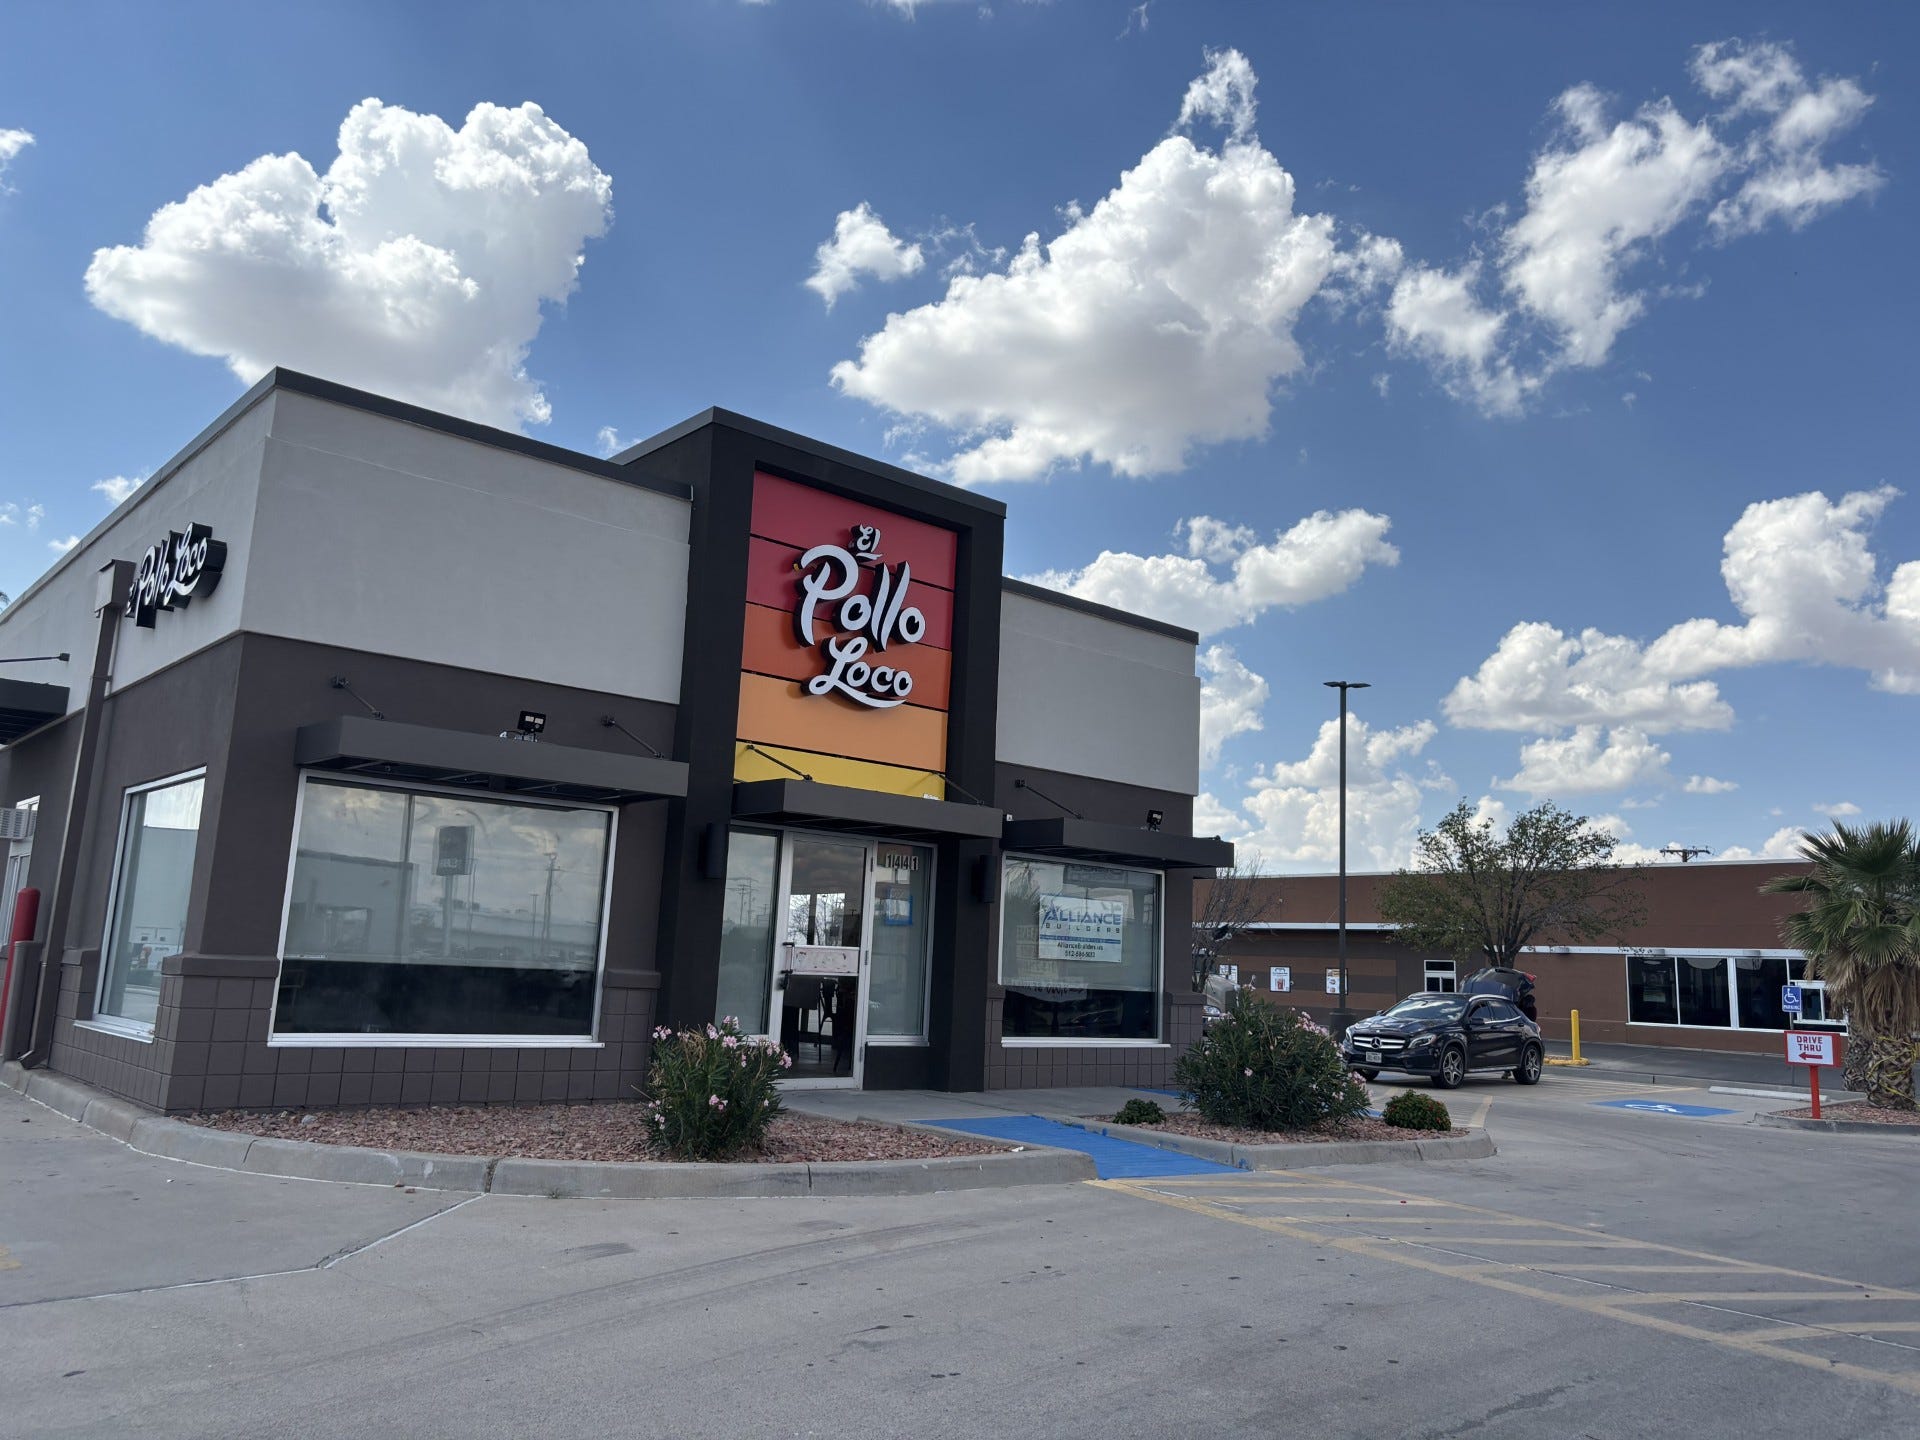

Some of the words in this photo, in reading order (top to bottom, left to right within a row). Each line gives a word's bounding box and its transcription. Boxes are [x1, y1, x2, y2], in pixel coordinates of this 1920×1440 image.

[855, 524, 882, 557] El
[135, 532, 170, 621] Pollo
[163, 522, 208, 607] Loco
[799, 544, 926, 651] Pollo
[808, 636, 913, 708] Loco
[886, 854, 918, 870] 1441
[1041, 901, 1121, 927] ALLIANCE
[1045, 923, 1120, 934] BUILDERS
[1796, 1035, 1823, 1044] DRIVE
[1798, 1044, 1822, 1052] THRU
